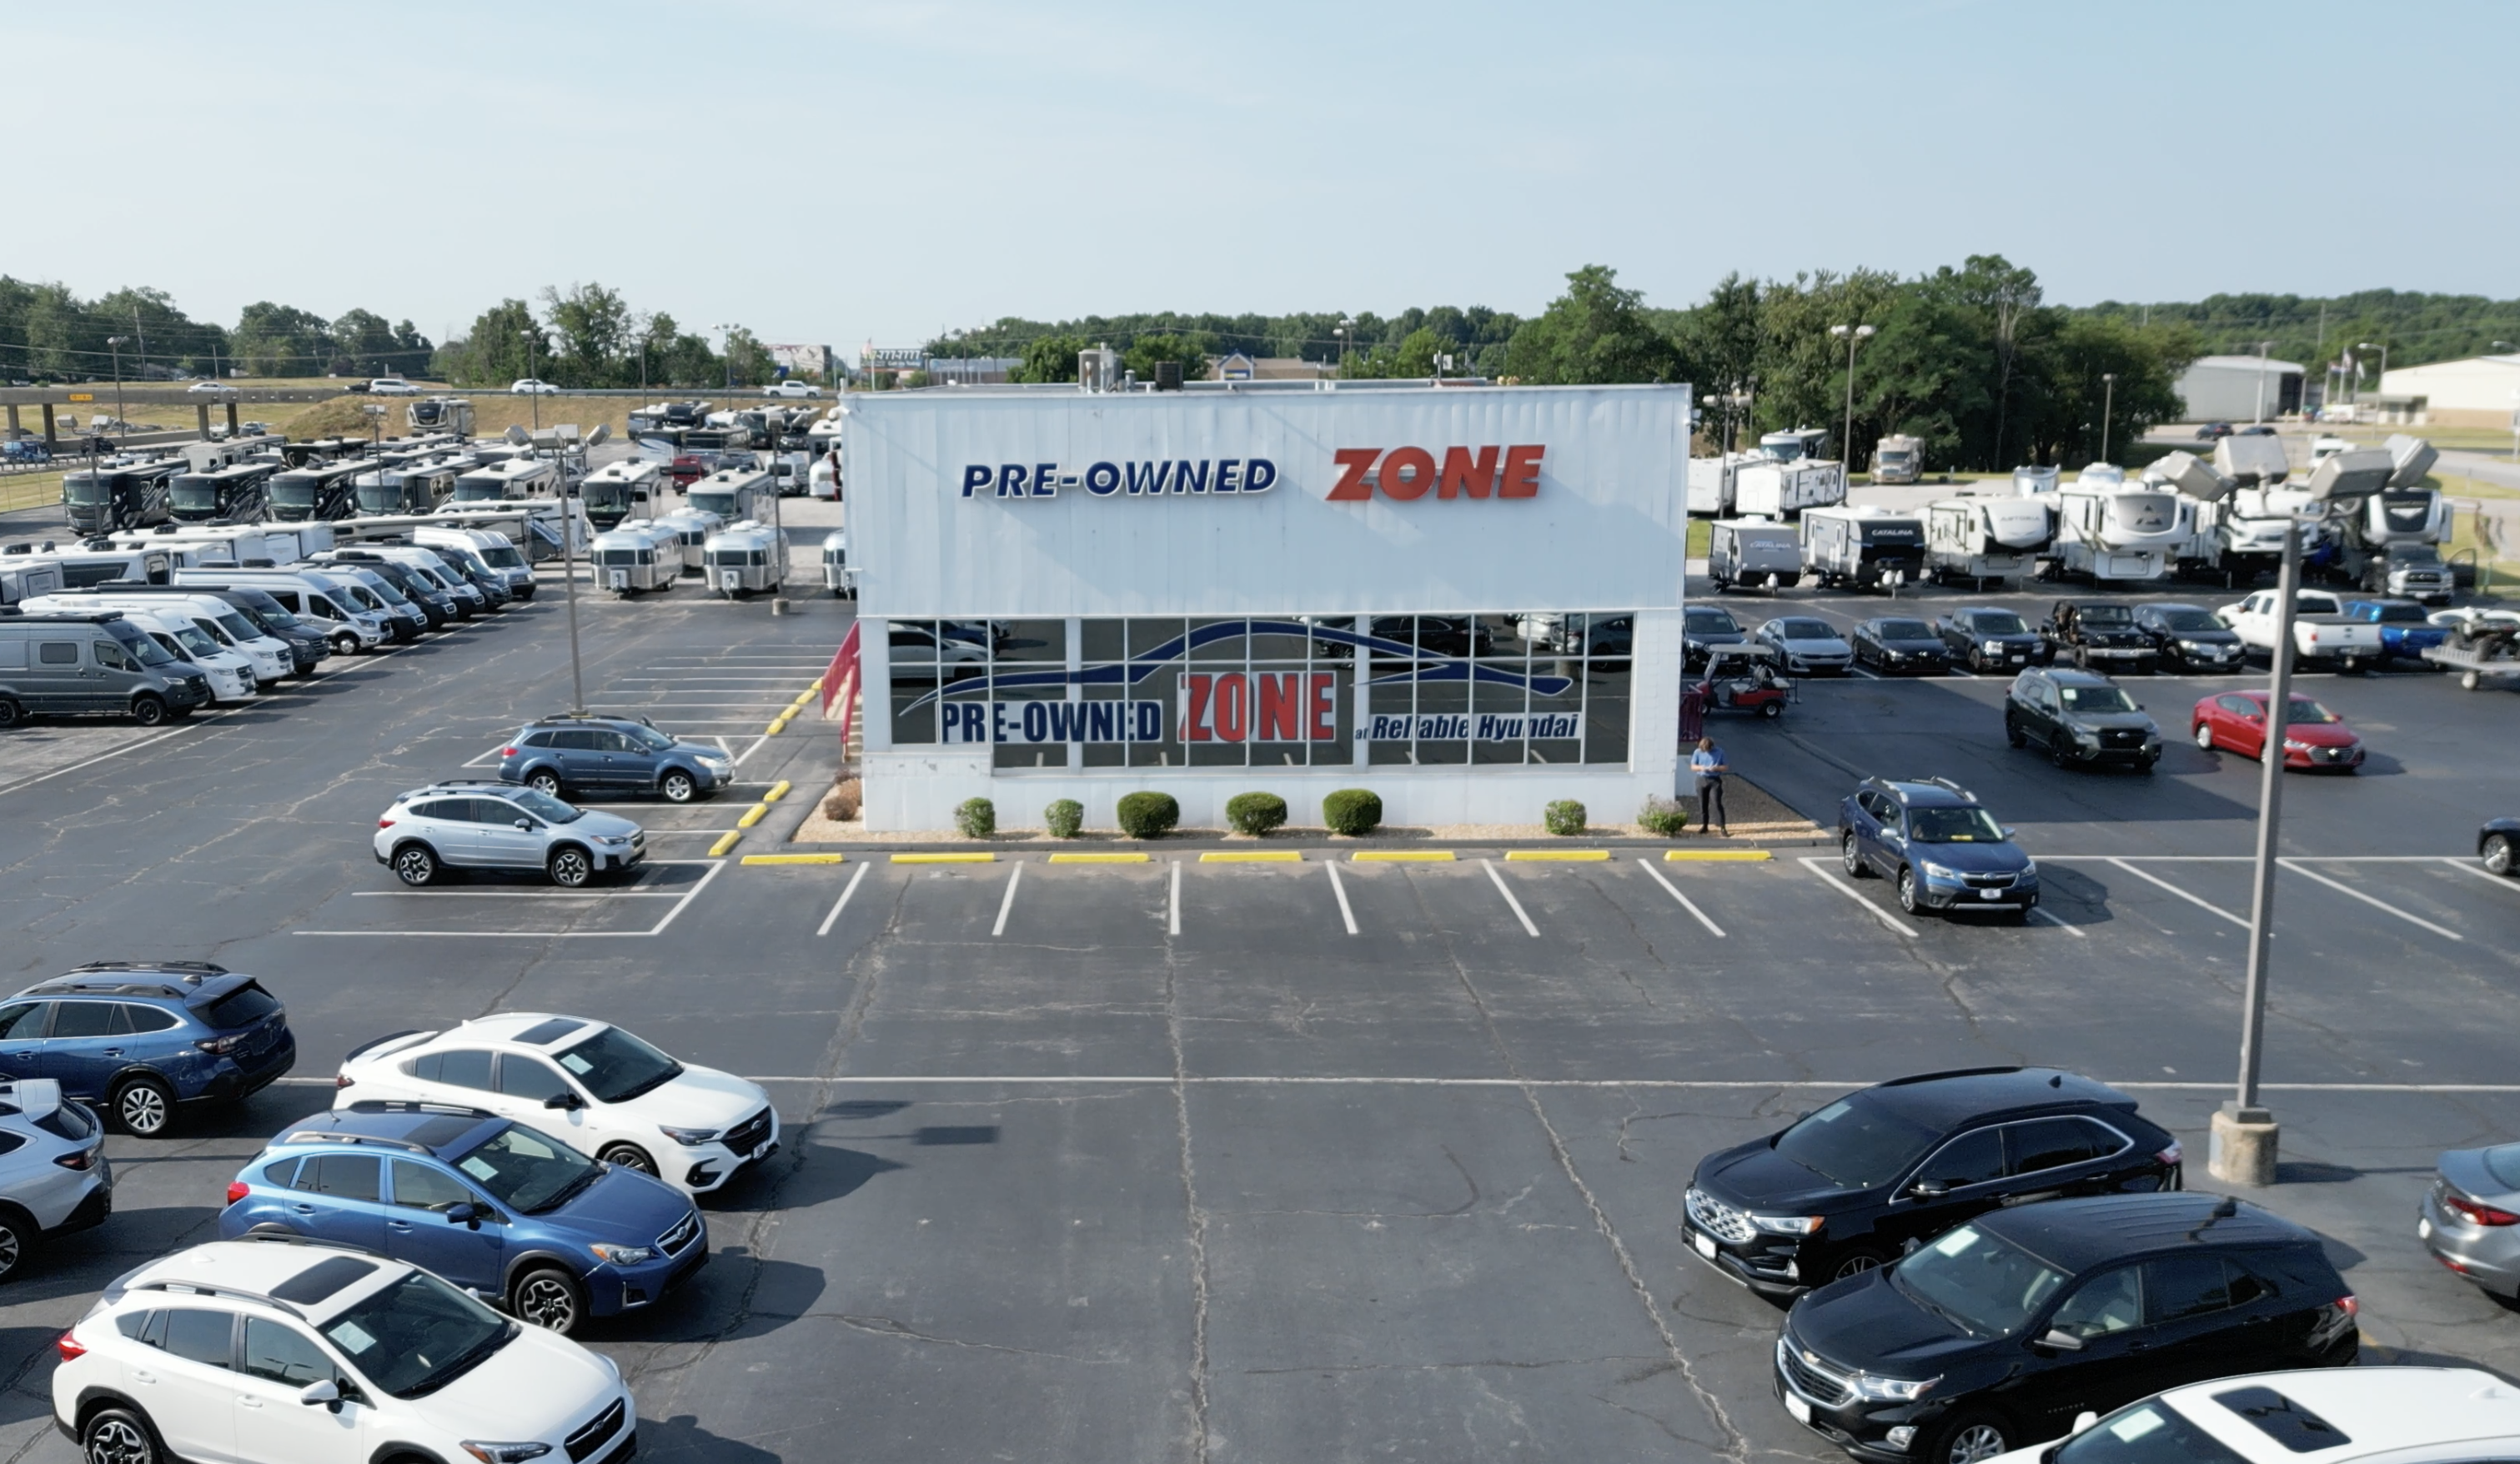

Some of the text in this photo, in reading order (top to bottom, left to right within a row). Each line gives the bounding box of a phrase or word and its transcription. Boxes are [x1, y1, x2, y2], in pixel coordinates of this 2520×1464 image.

[961, 444, 1546, 501] PRE-OWNED ZONE
[942, 700, 1162, 743] PRE-OWNED
[1178, 672, 1334, 743] ZONE
[1355, 727, 1368, 740] at
[1477, 714, 1579, 741] Hyundai
